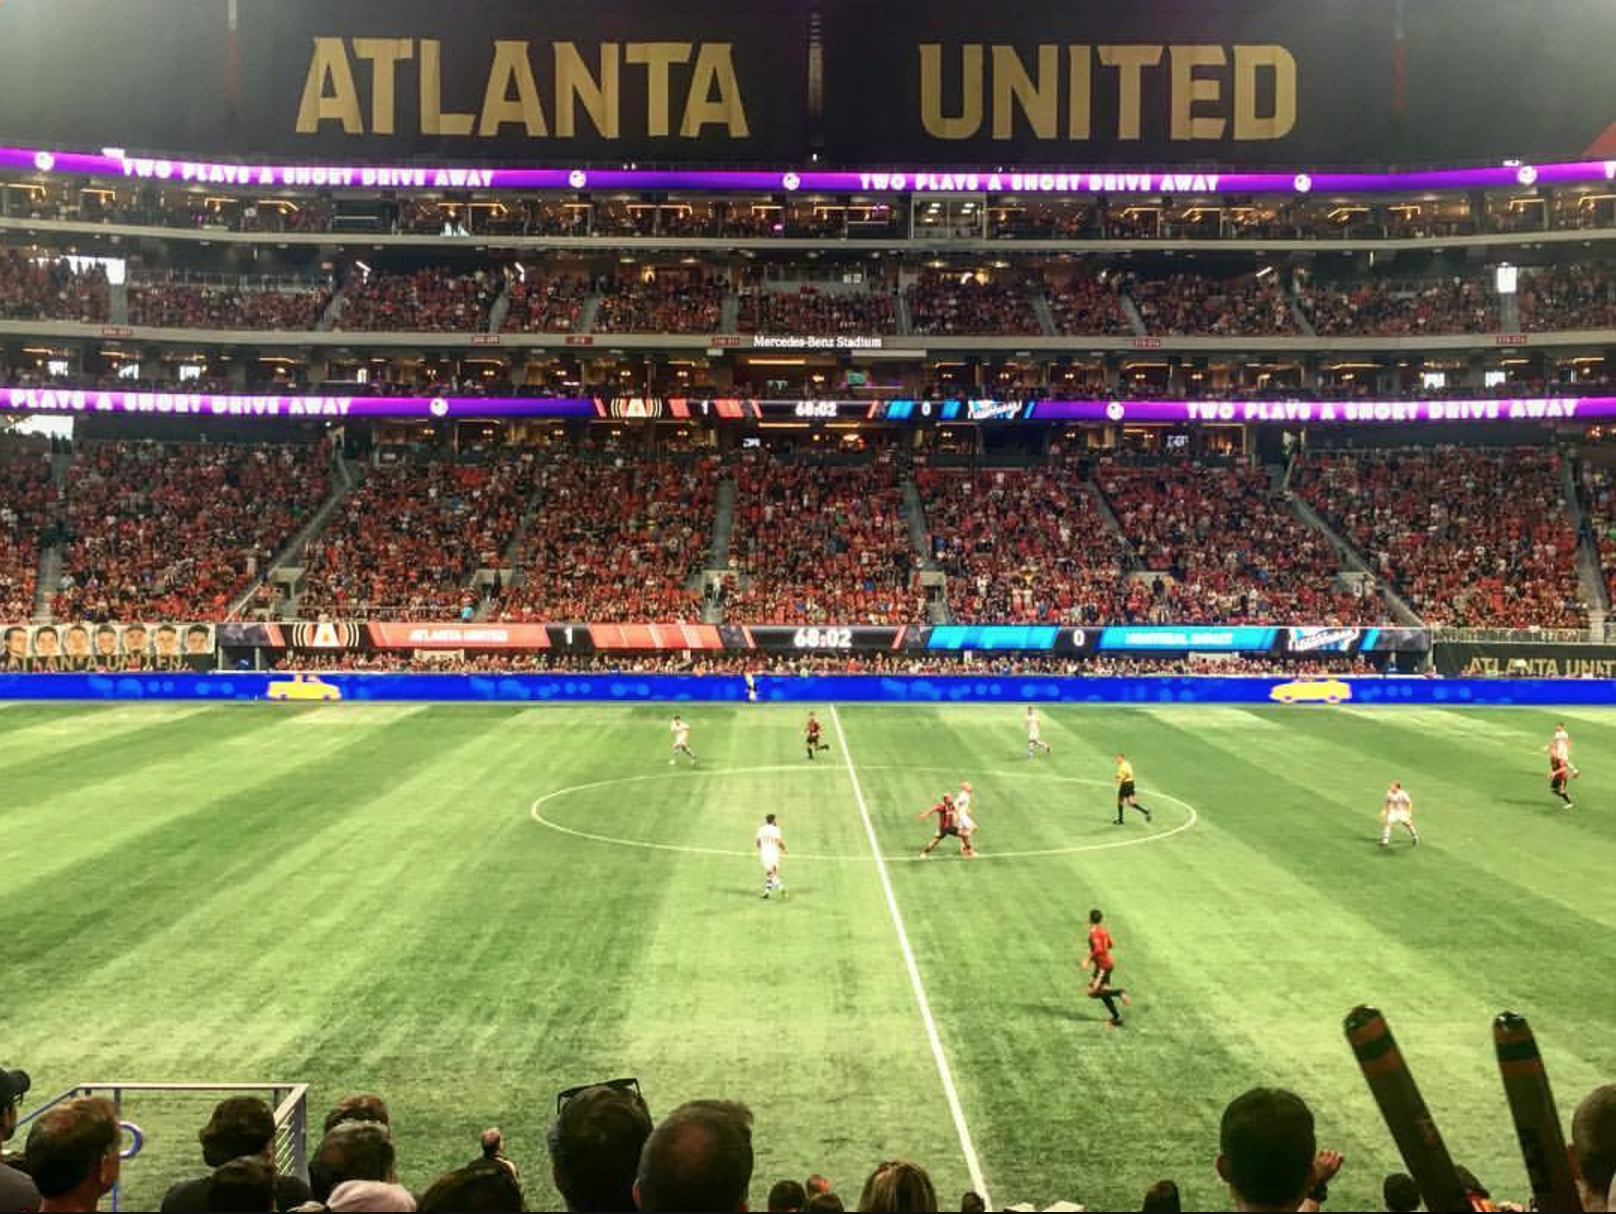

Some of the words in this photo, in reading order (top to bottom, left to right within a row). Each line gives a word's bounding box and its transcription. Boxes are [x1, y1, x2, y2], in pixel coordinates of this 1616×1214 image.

[296, 37, 749, 139] ATLANTA
[919, 44, 1297, 140] UNITED
[122, 157, 172, 177] TWO
[182, 164, 249, 183] PLAYS
[259, 167, 273, 184] A
[283, 167, 352, 185] SHORT
[361, 169, 425, 186] DRIVE
[434, 170, 494, 187] AWAY
[860, 174, 906, 191] TWO
[915, 174, 978, 191] PLAYS
[987, 174, 1002, 191] A
[1011, 174, 1080, 191] SHORT
[1089, 174, 1151, 191] DRIVE
[1160, 174, 1219, 191] AWAY
[753, 335, 834, 347] Mercedes-Benz
[836, 336, 882, 347] Stadium
[10, 388, 86, 409] PLAYS
[96, 391, 113, 410] A
[123, 393, 202, 412] SHORT
[211, 395, 282, 414] DRIVE
[289, 396, 351, 415] AWAY
[701, 400, 709, 415] 1
[921, 401, 931, 416] 0
[1187, 401, 1234, 419] TWO
[1245, 401, 1311, 419] PLAYS
[1320, 402, 1335, 419] A
[1345, 401, 1418, 419] SHORT
[1428, 401, 1499, 418] DRIVE
[1509, 399, 1578, 417] AWAY
[564, 627, 573, 645] 1
[793, 628, 853, 647] 68:02
[1073, 629, 1085, 646] 0
